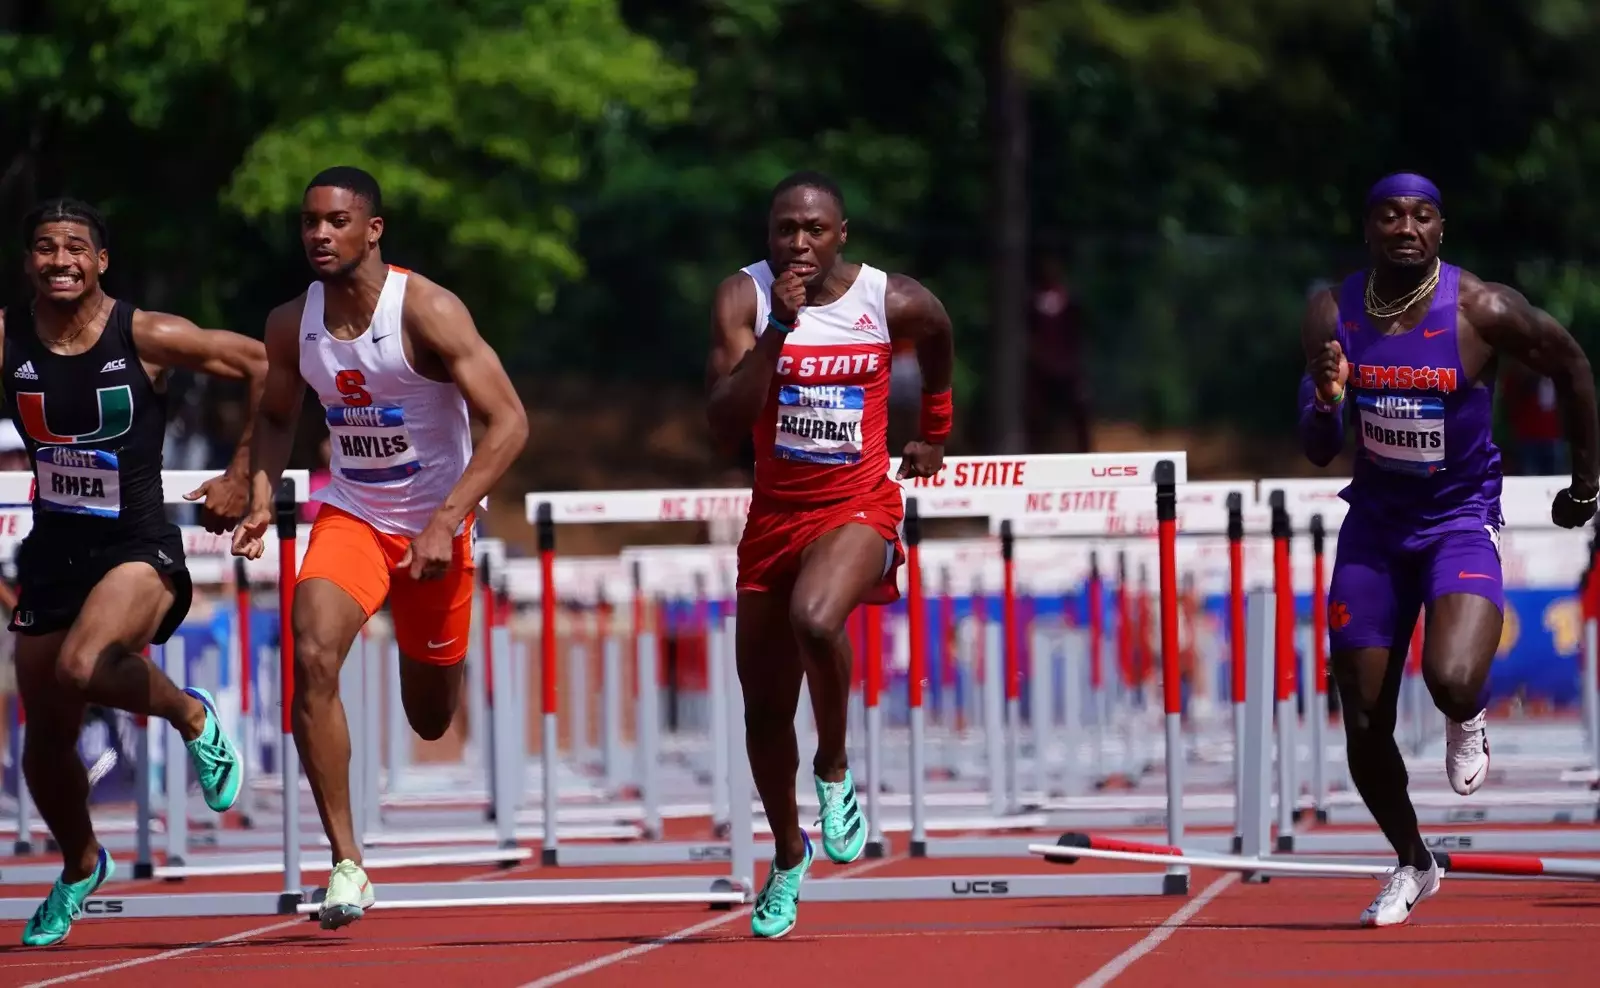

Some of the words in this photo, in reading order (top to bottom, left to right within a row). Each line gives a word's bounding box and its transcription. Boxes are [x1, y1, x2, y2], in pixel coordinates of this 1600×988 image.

[14, 371, 38, 380] adidas
[100, 358, 126, 373] ACC
[776, 356, 794, 376] C
[798, 353, 880, 377] STATE
[335, 369, 373, 407] S
[17, 385, 133, 443] U
[343, 406, 385, 427] UNITE
[1375, 395, 1423, 419] UNITE
[780, 415, 856, 442] MURRAY
[1364, 421, 1441, 449] ROBERTS
[53, 447, 98, 468] UNITE
[339, 435, 409, 458] HAYLES
[953, 461, 1027, 487] STATE
[1091, 466, 1138, 477] UCS
[51, 472, 105, 498] RHEA
[1026, 493, 1053, 512] NC
[1058, 491, 1119, 512] STATE
[1425, 836, 1471, 848] UCS
[952, 881, 1009, 894] UCS
[85, 900, 123, 914] CS
